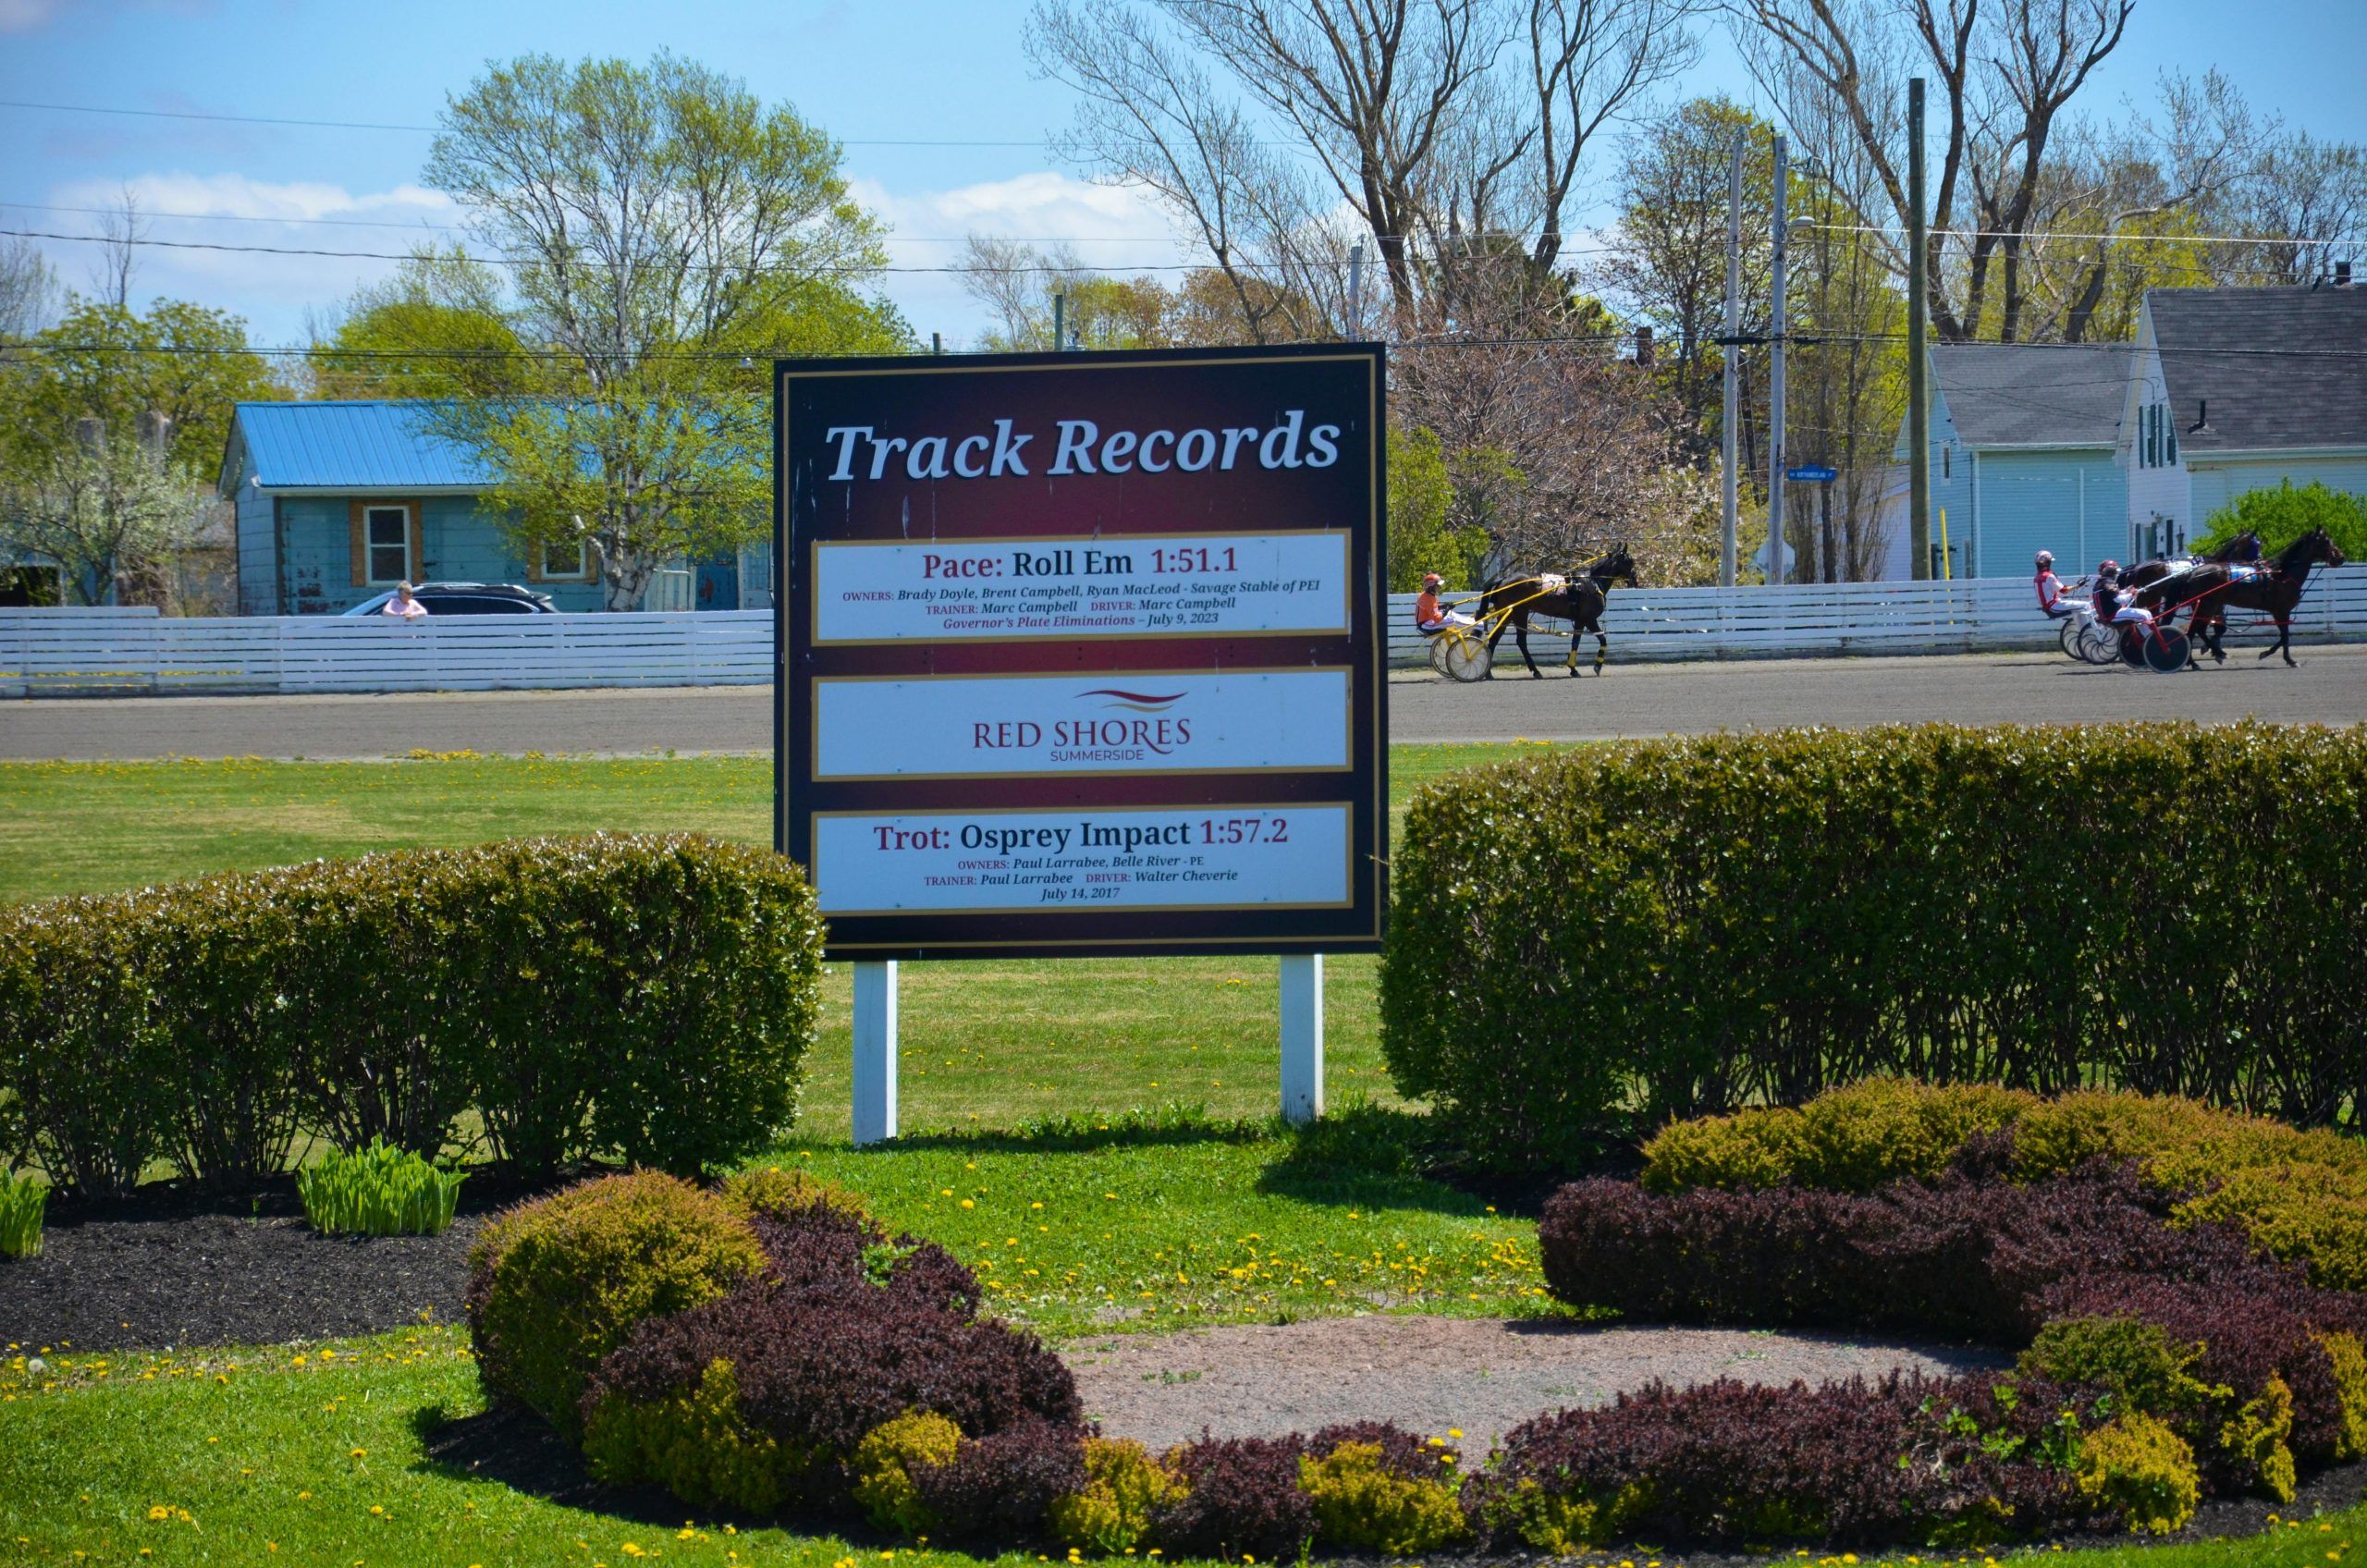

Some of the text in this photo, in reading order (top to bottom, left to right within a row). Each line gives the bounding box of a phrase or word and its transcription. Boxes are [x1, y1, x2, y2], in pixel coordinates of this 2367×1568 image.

[827, 410, 1340, 480] Track Records
[922, 546, 1238, 579] Pace: Roll Em 1:51.1
[842, 591, 893, 602] OWNERS:
[897, 588, 937, 603] Brady
[938, 587, 978, 602] Doyle,
[981, 588, 1017, 599] Brent
[1020, 584, 1083, 600] Campbell,
[1086, 584, 1119, 599] Ryan
[1122, 582, 1181, 595] MacLeod
[1190, 582, 1237, 596] Savage
[1238, 580, 1280, 593] Stable
[1282, 580, 1298, 594] of
[1298, 580, 1320, 592] PEI
[925, 596, 1236, 616] TRAINER: Marc Campbell DRIVER: Marc Campbell
[1017, 616, 1050, 628] Plate
[1052, 614, 1135, 628] Eliminations
[1147, 613, 1173, 628] July
[1175, 613, 1187, 626] 9,
[1189, 612, 1220, 624] 2023
[973, 719, 1192, 754] RED SHORES
[1049, 748, 1145, 763] SUMMERSIDE
[873, 818, 1288, 856] Trot: Osprey Impact 1:57.2
[957, 860, 1010, 870] OWNERS:
[1012, 857, 1043, 869] Paul
[1045, 856, 1109, 869] Larrabee,
[1111, 855, 1144, 867] Belle
[1146, 854, 1182, 867] River
[1189, 856, 1205, 866] PE
[924, 869, 1239, 887] TRAINER: Paul Larrabee DRIVER: Walter Cheverie
[1040, 887, 1121, 902] July 14, 2017
